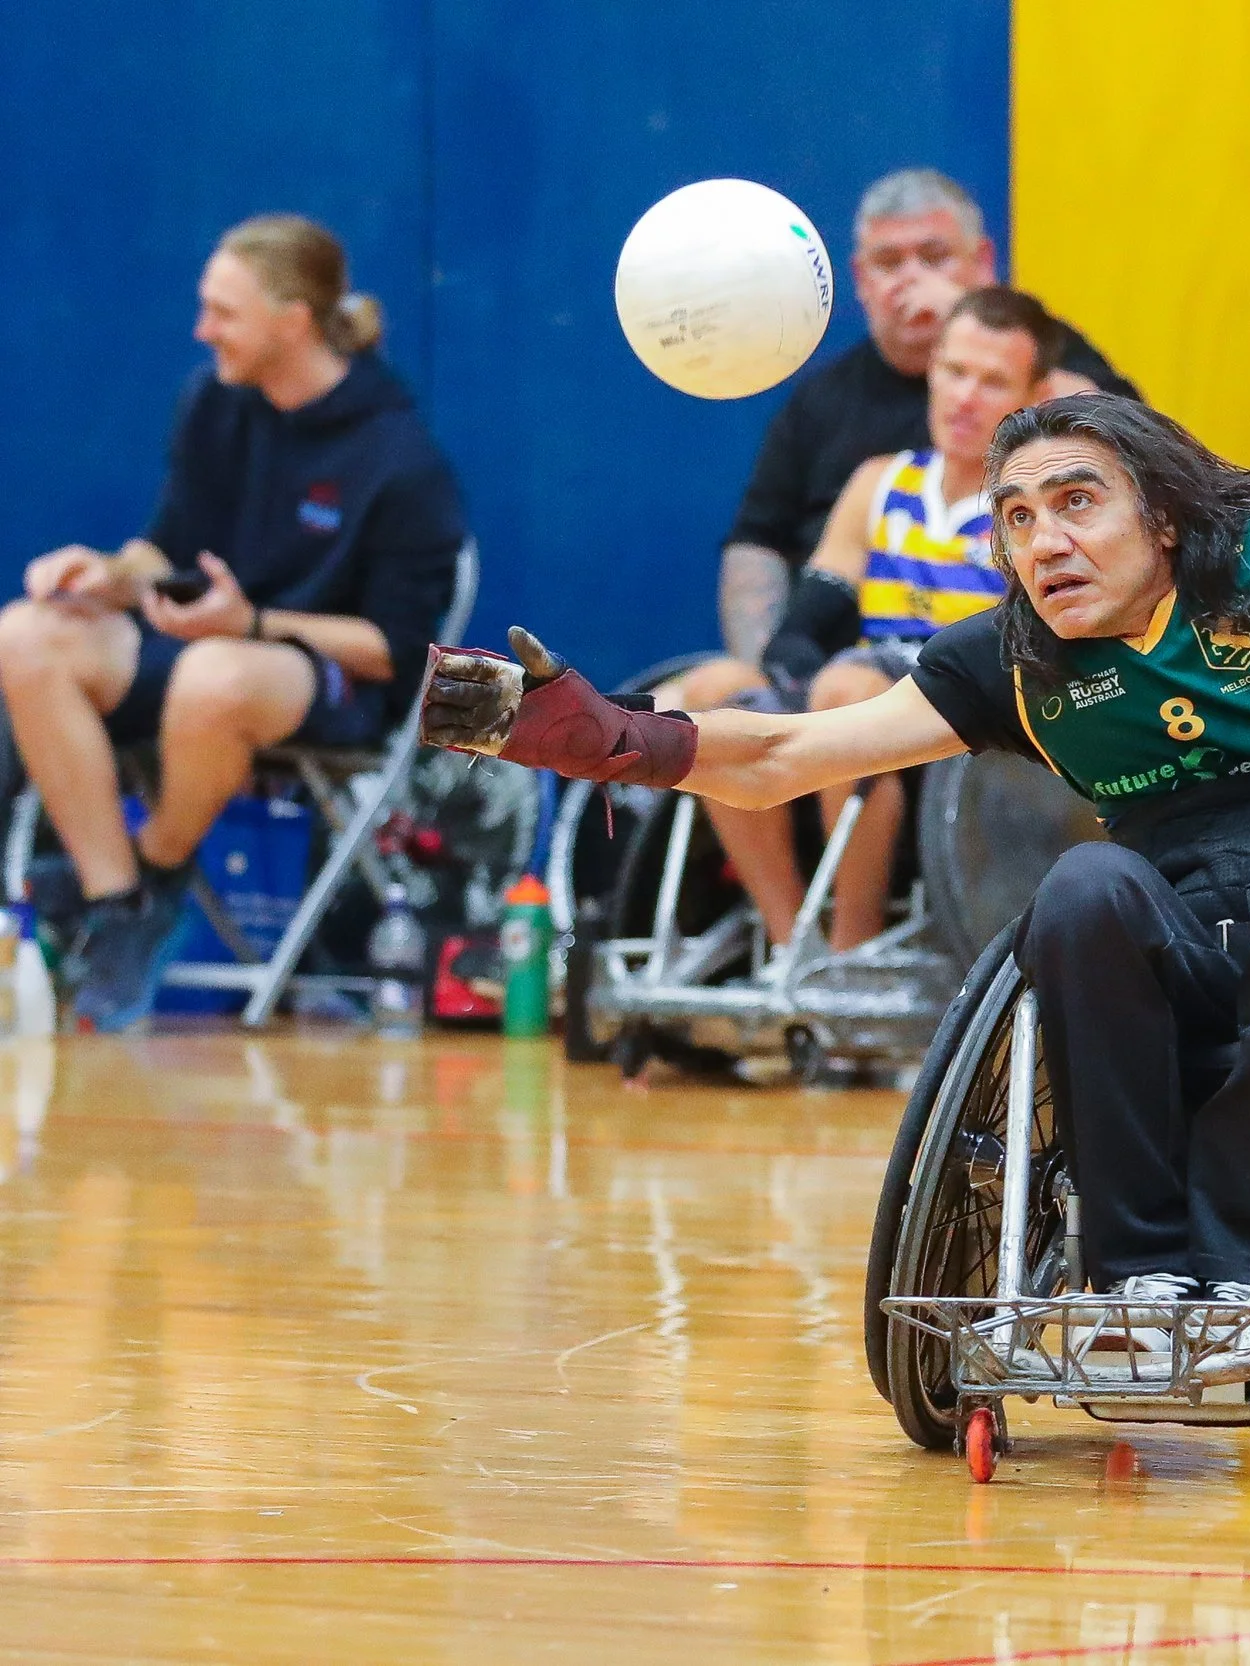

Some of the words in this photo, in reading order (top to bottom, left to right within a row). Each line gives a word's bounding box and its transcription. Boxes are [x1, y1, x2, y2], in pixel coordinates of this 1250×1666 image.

[1069, 674, 1120, 701] RUGBY
[1075, 687, 1127, 710] AUSTRALIA
[1160, 697, 1205, 740] 8
[1094, 764, 1176, 796] future
